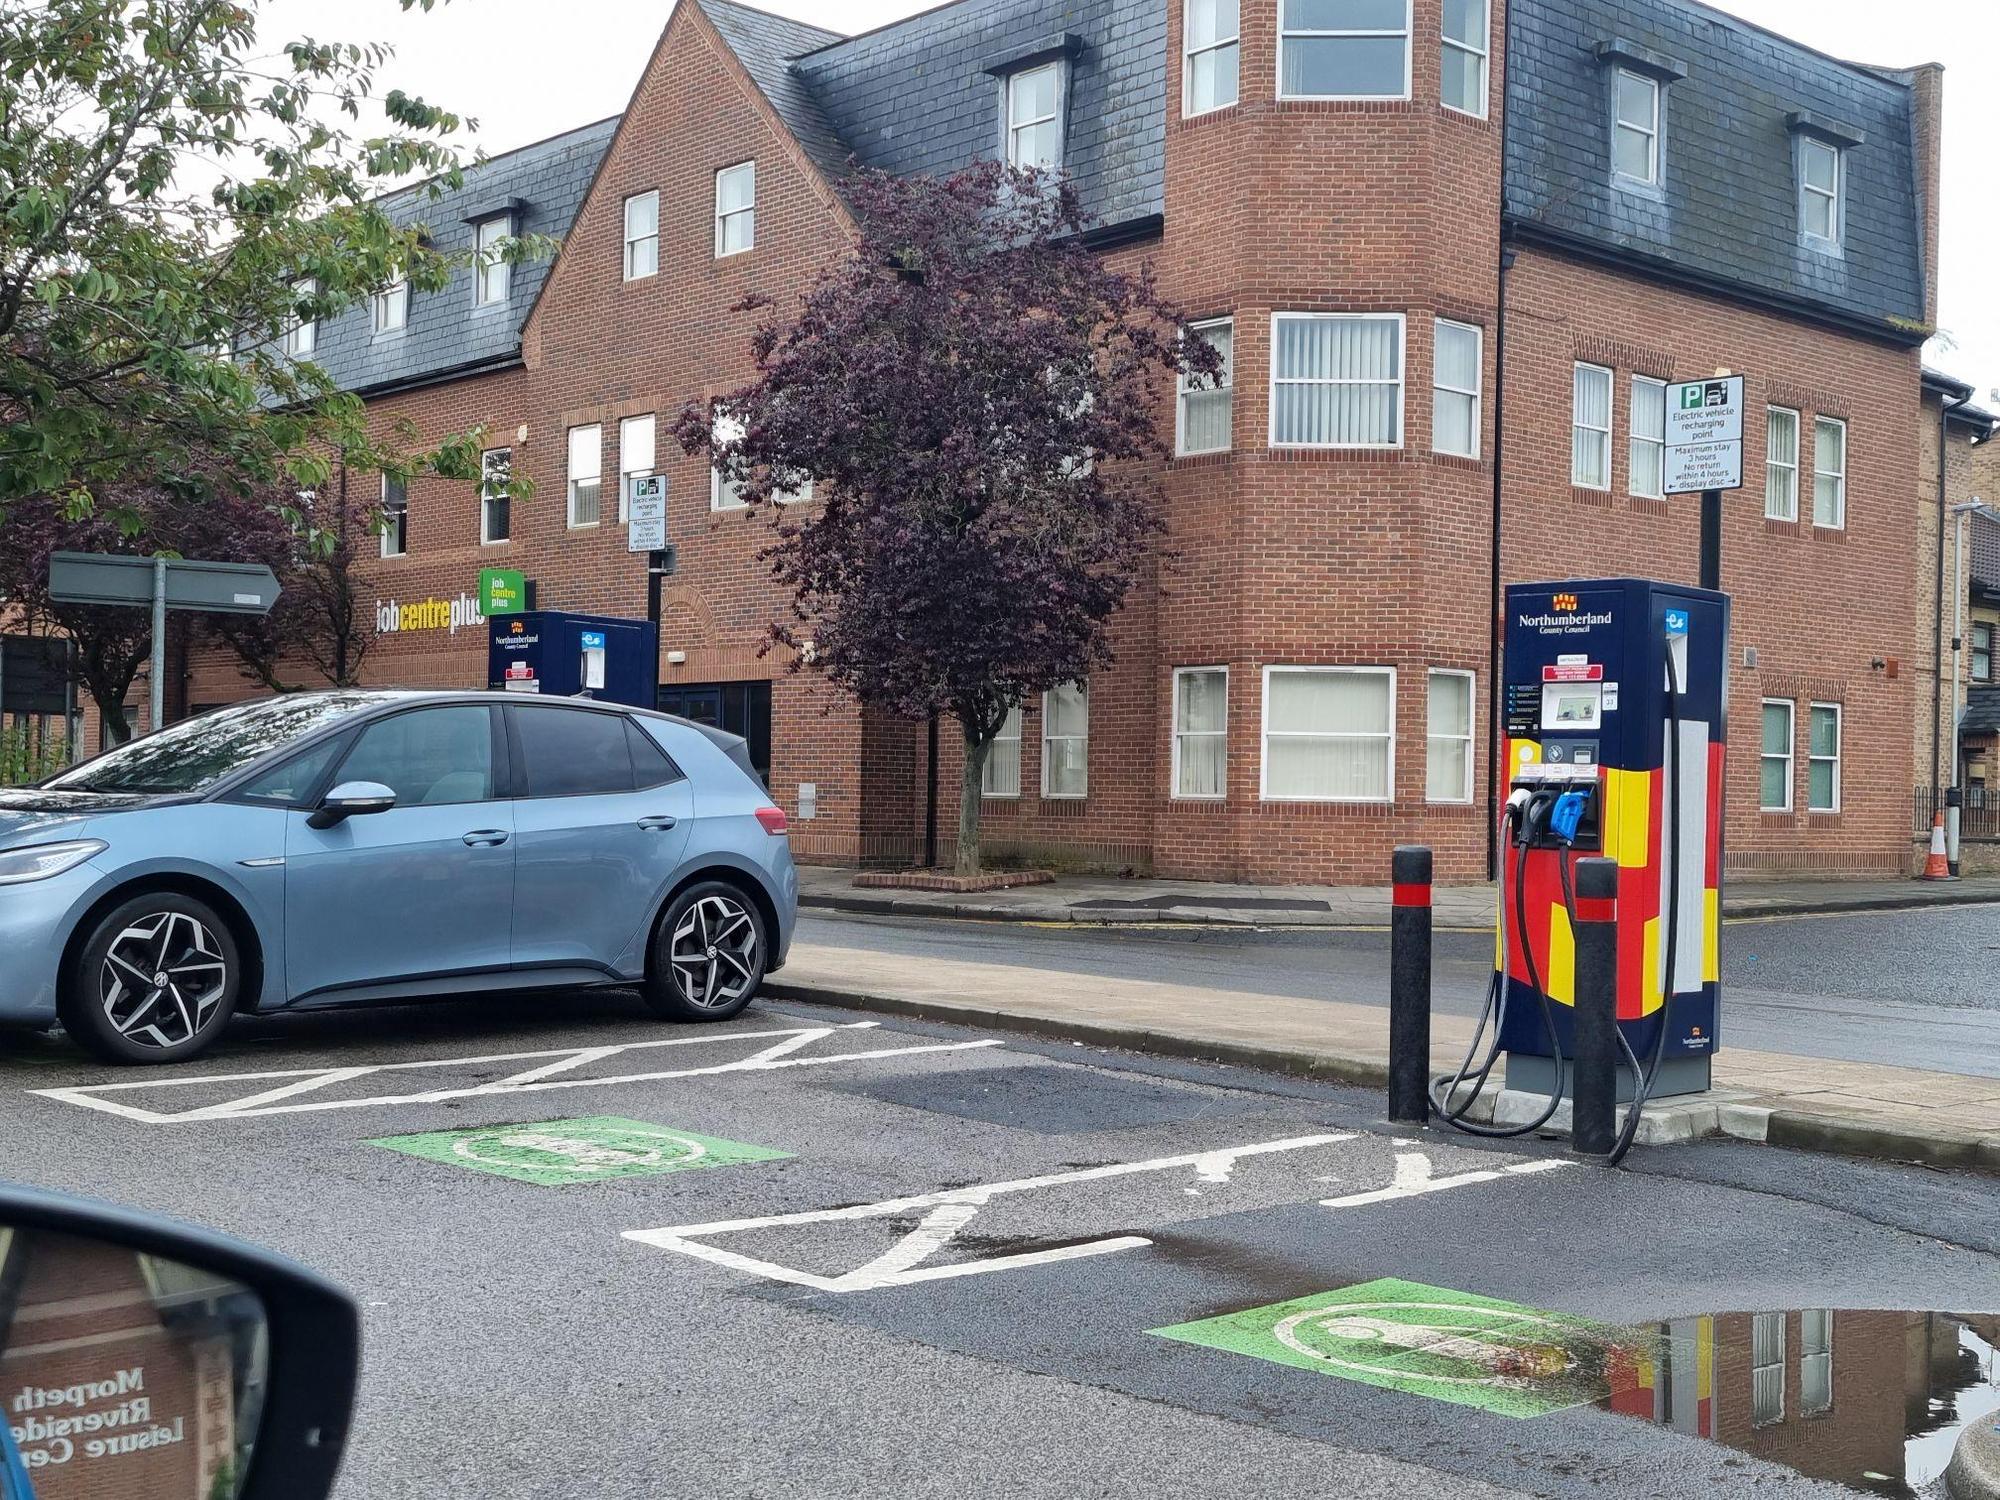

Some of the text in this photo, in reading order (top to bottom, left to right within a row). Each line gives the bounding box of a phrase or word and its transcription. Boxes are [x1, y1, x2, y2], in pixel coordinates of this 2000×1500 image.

[1685, 386, 1700, 408] P
[1673, 408, 1735, 421] Electric vehicle
[1681, 419, 1725, 430] recharging
[1692, 430, 1713, 440] point
[1675, 445, 1713, 455] Maximum
[1676, 472, 1700, 480] within
[1679, 478, 1725, 489] display disc
[491, 577, 504, 588] job
[491, 588, 516, 598] centre
[491, 597, 508, 608] plus
[1519, 611, 1612, 627] Northumberland
[1539, 625, 1590, 635] County Council
[495, 634, 539, 645] Northumberland
